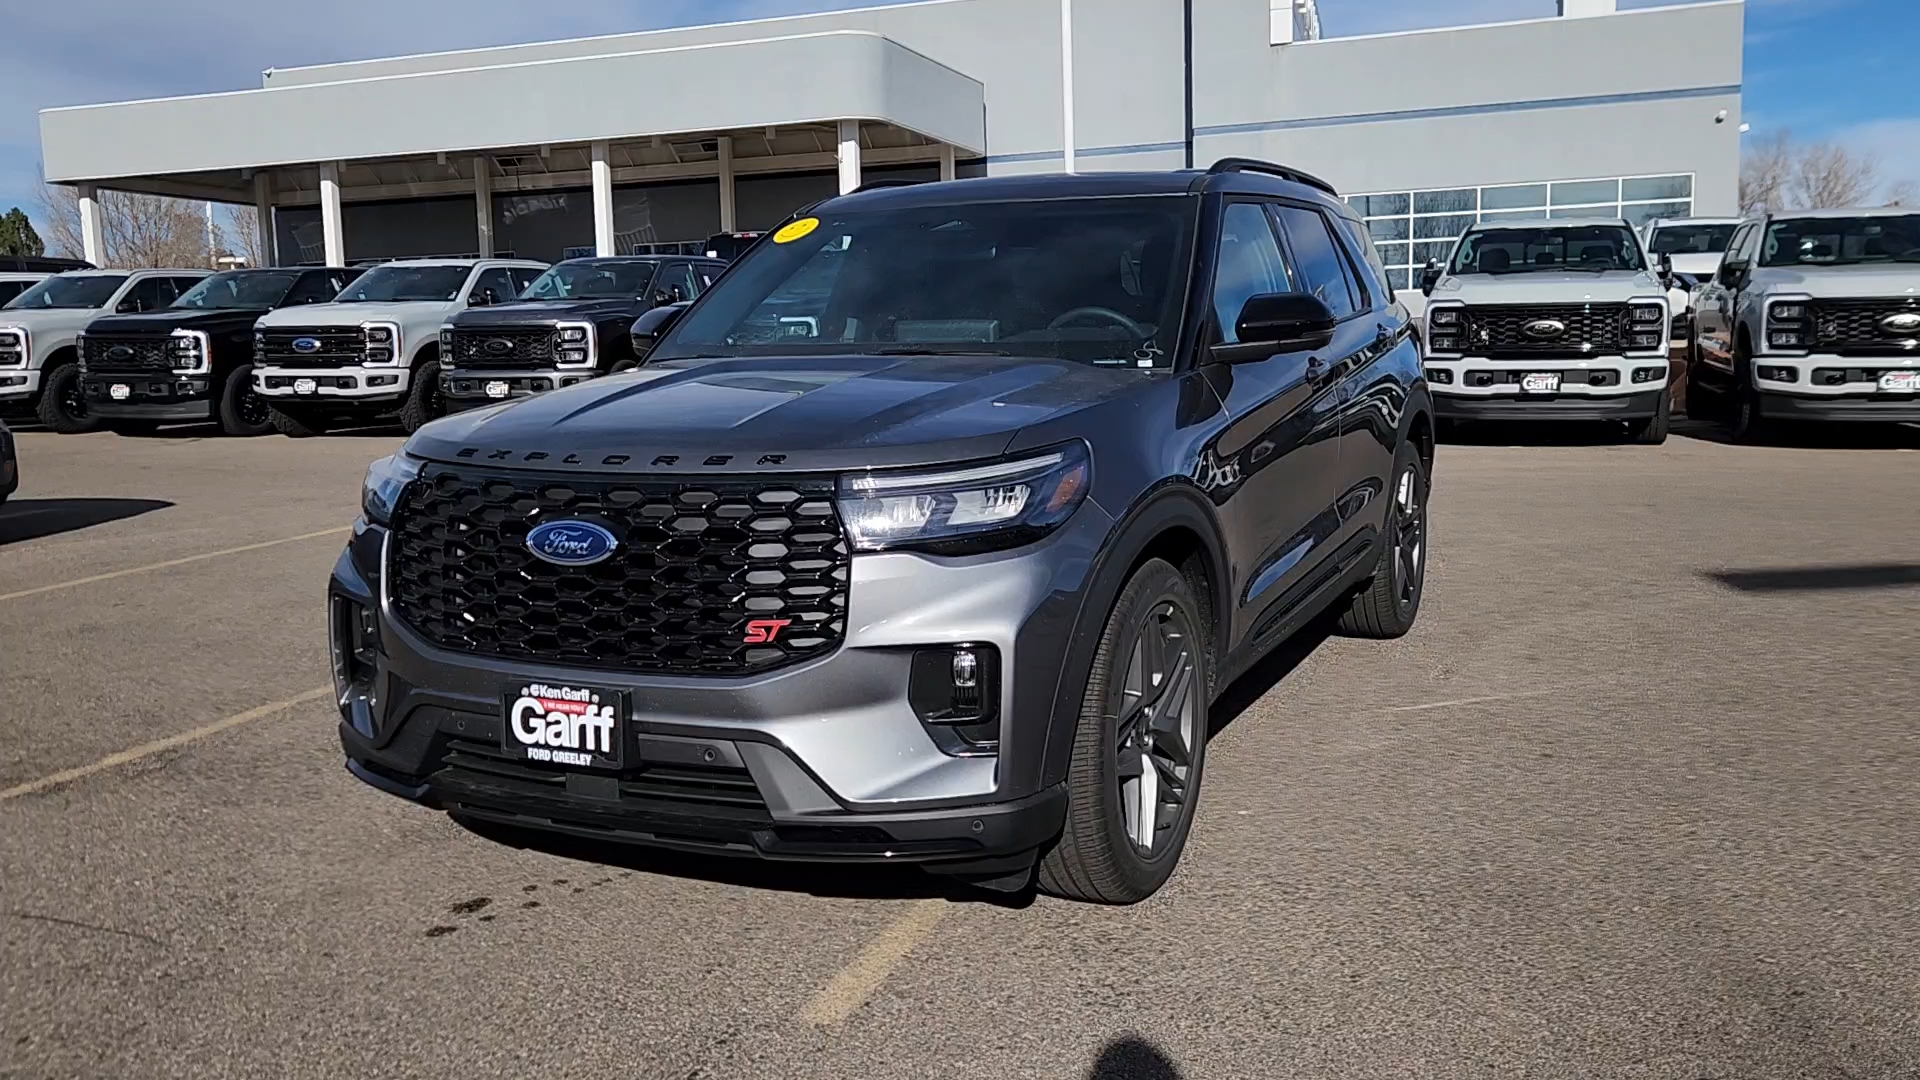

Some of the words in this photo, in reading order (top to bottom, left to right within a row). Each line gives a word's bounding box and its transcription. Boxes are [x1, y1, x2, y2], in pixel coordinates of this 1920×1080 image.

[1522, 376, 1559, 390] Garff
[455, 447, 788, 467] EXPLORER
[544, 528, 594, 555] Ford
[743, 619, 792, 643] ST
[540, 684, 561, 700] Ken
[561, 686, 590, 703] Garff
[511, 696, 615, 753] Garff
[527, 747, 551, 761] FORD
[552, 750, 592, 767] GREELEY
